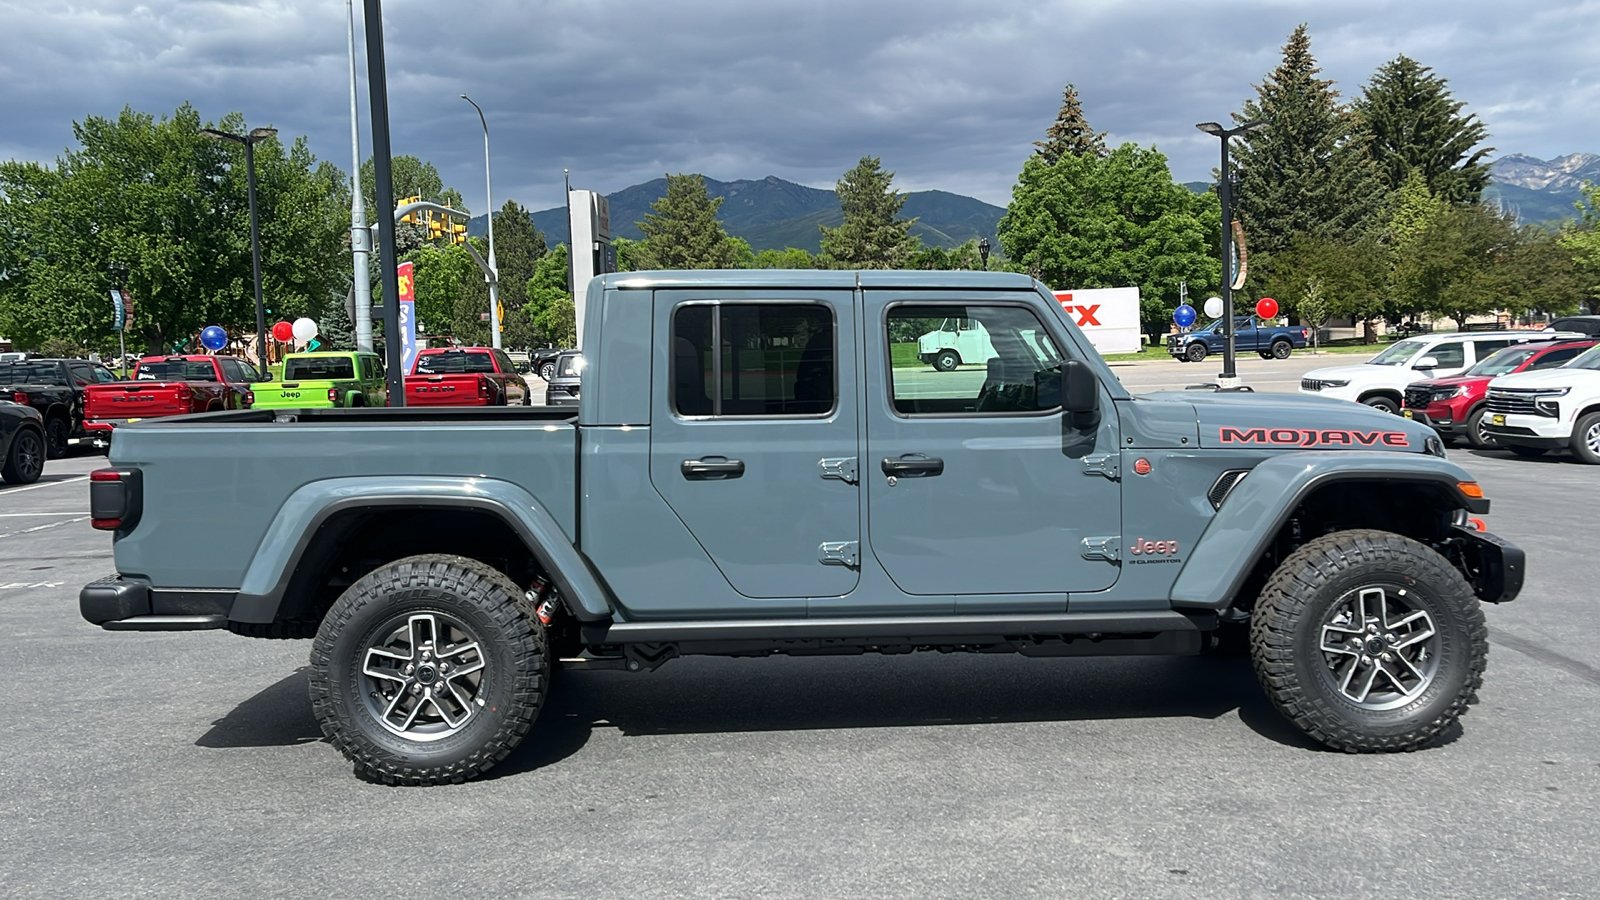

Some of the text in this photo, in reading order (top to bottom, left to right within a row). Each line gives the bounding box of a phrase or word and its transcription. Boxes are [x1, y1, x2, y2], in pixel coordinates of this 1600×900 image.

[1054, 293, 1102, 327] x
[280, 390, 301, 398] Jeep
[1219, 426, 1410, 448] MOJAVE
[1130, 537, 1179, 557] Jeep
